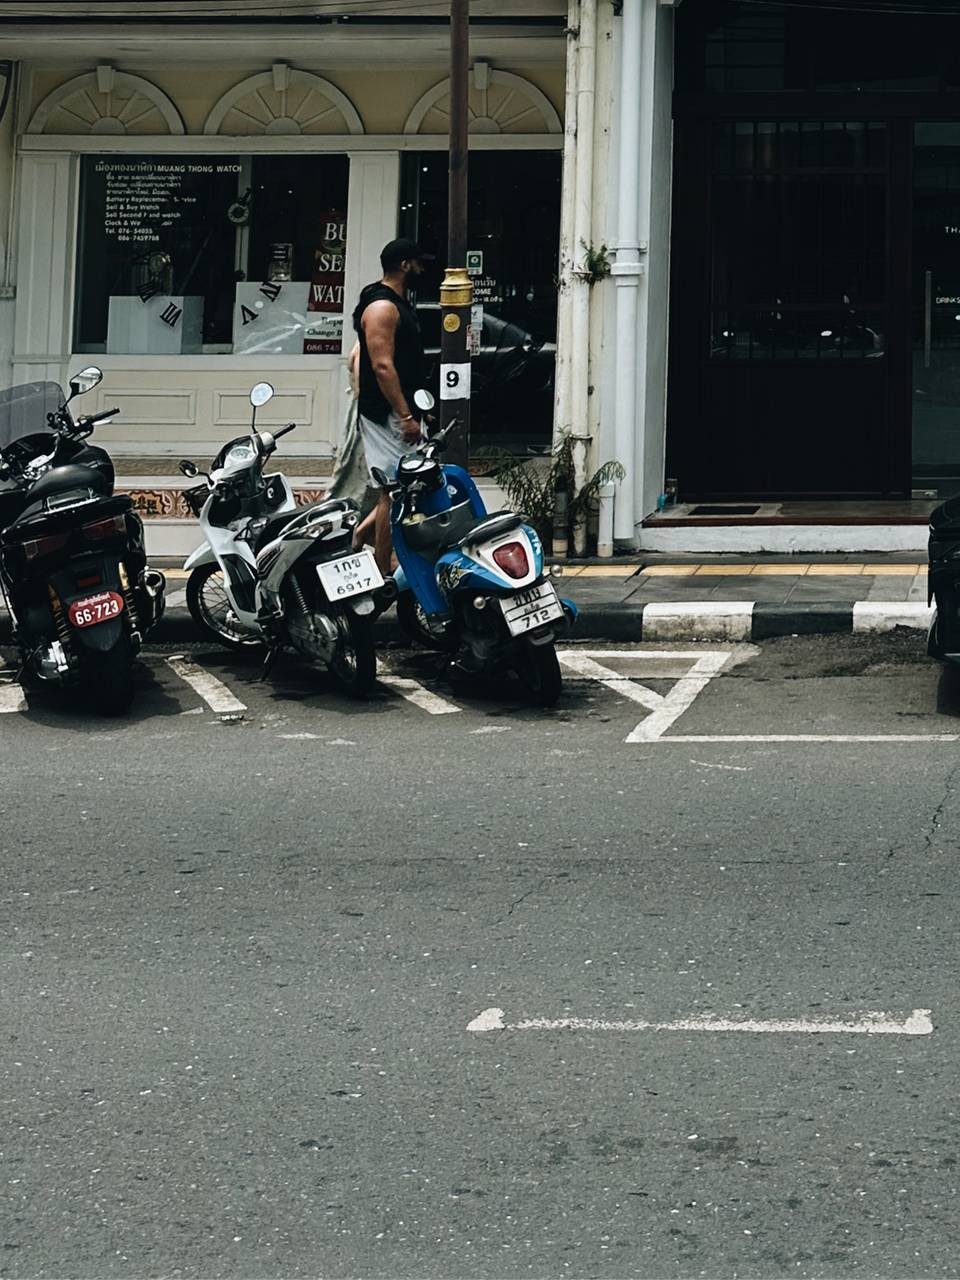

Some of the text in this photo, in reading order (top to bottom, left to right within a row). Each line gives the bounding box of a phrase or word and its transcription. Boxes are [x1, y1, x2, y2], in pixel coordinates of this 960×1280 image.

[157, 164, 186, 173] MUANG
[188, 165, 214, 173] THONG
[216, 165, 242, 173] WATCH
[446, 370, 460, 388] 9
[337, 577, 372, 595] 6917
[521, 609, 551, 629] 712
